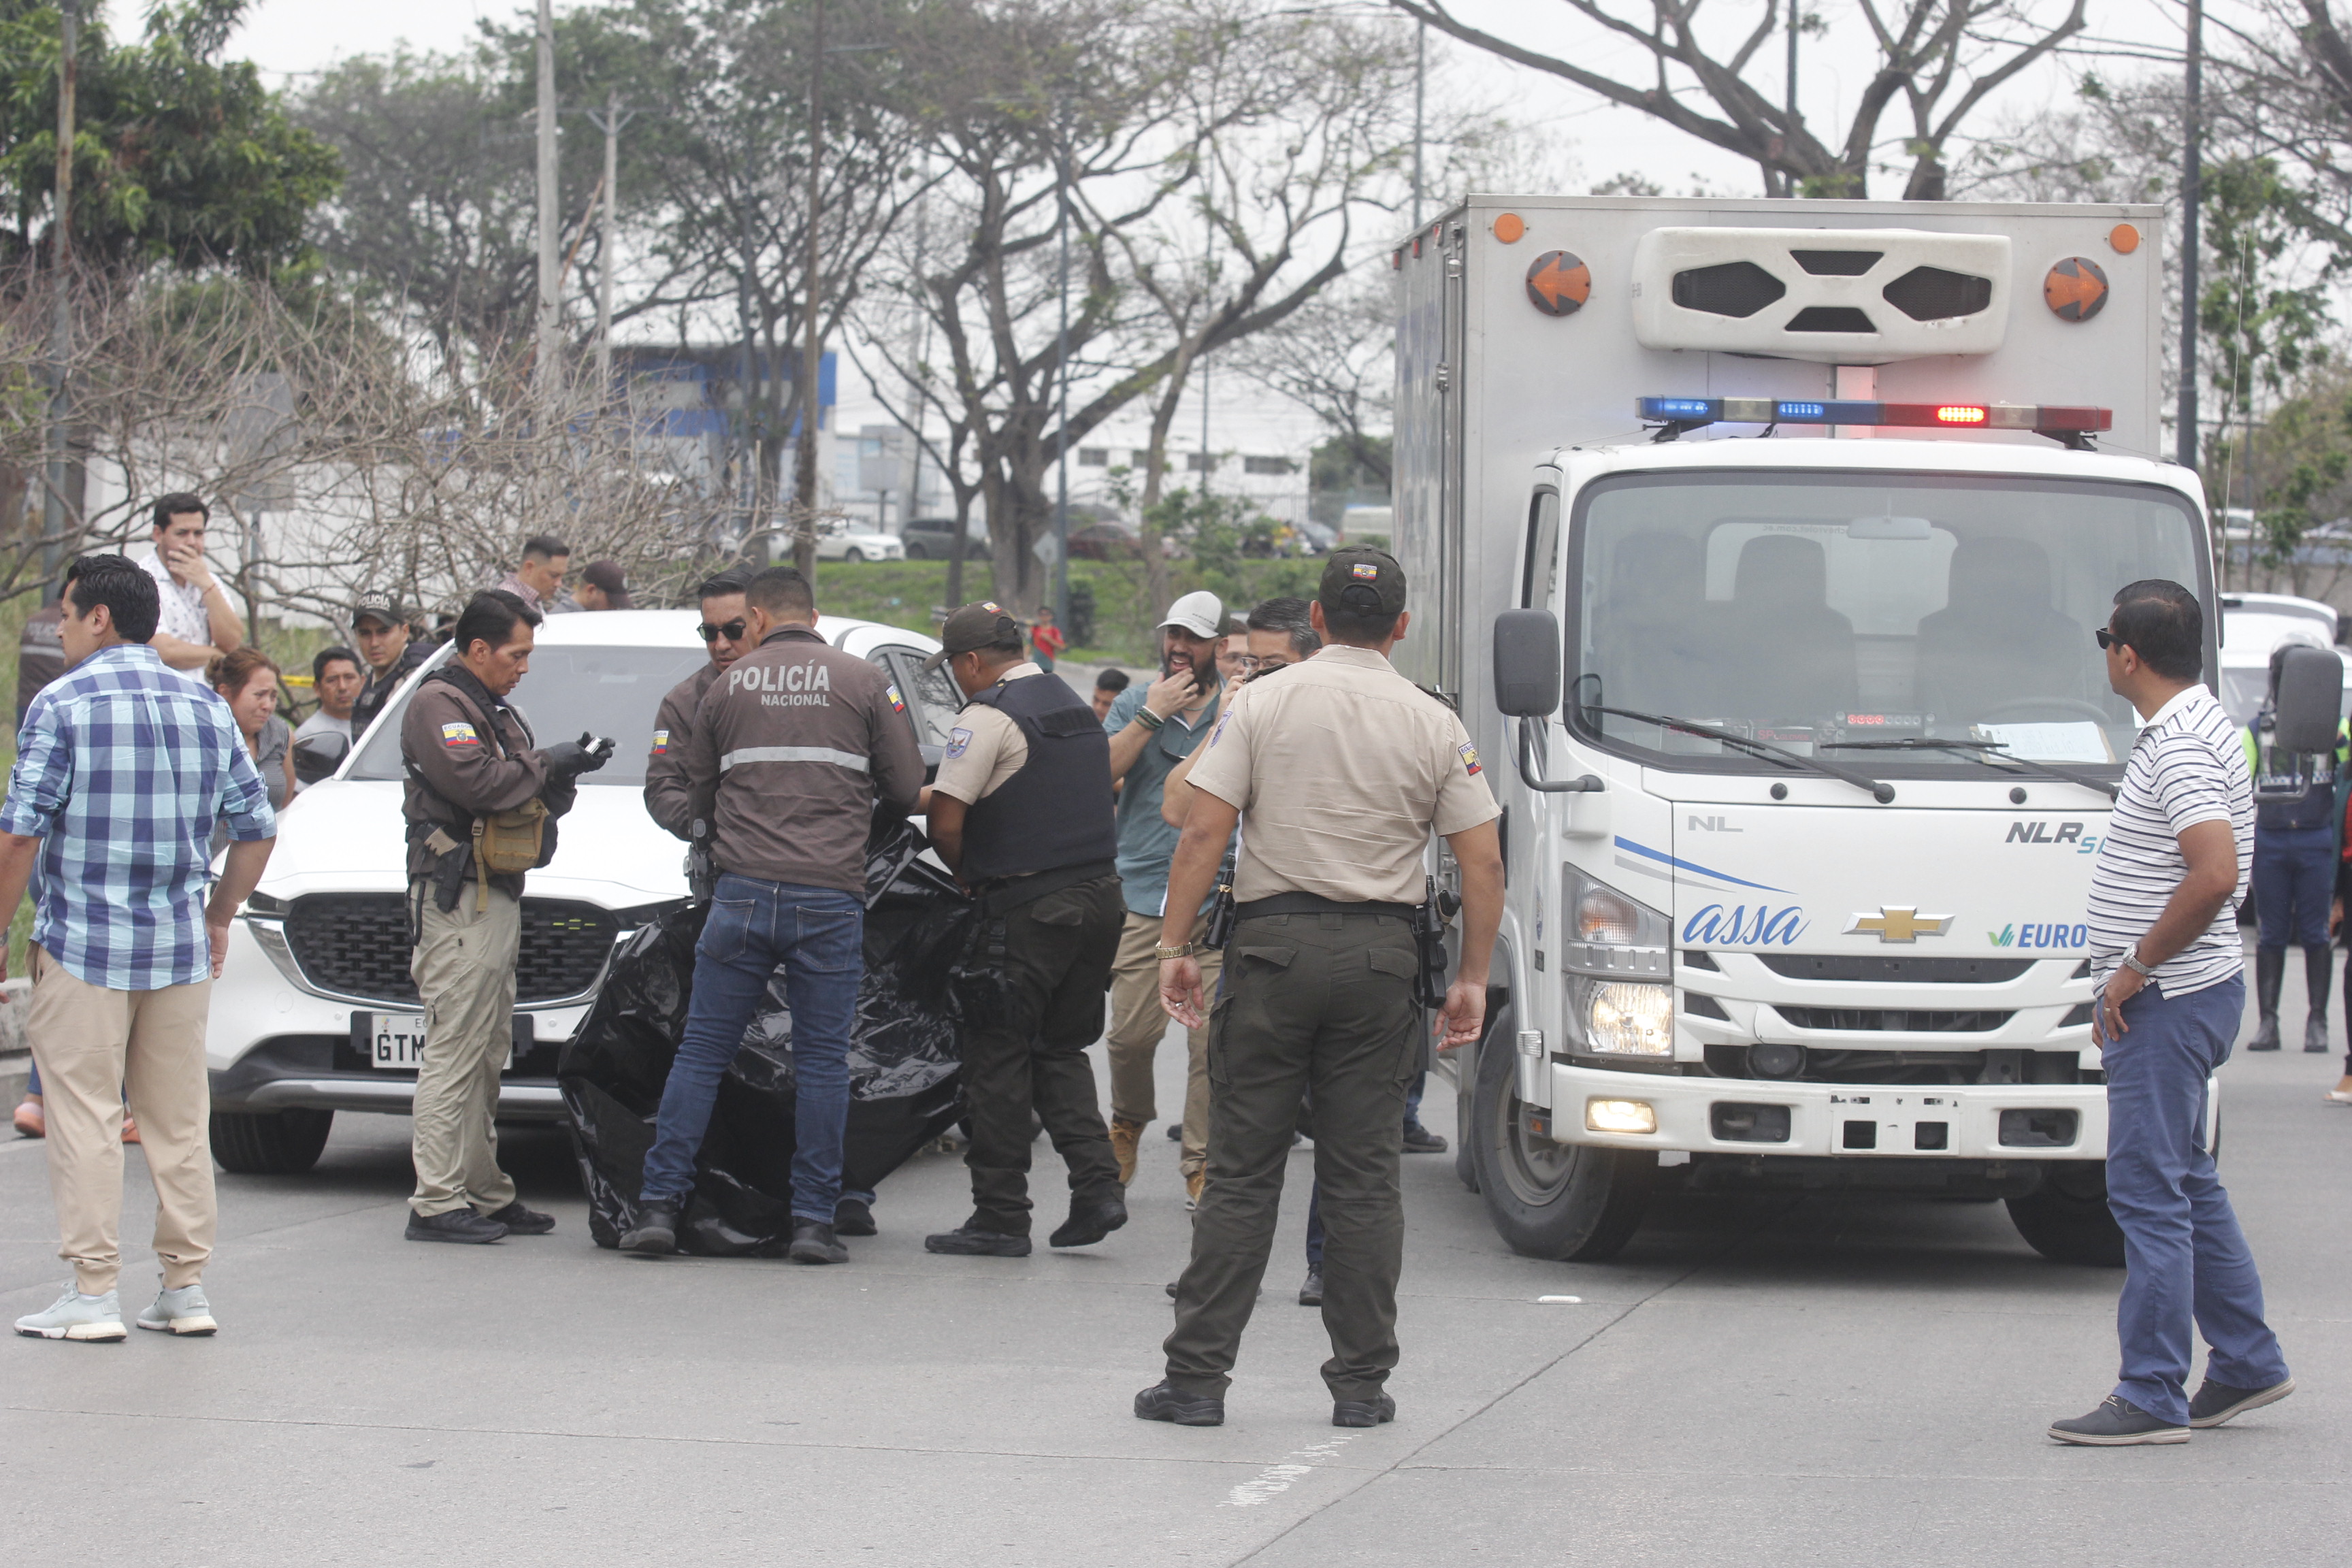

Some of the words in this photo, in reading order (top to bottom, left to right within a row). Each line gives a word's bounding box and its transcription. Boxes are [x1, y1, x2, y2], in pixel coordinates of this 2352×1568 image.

[729, 659, 830, 696] POLICÍA
[761, 693, 830, 707] NACIONAL
[1688, 815, 1744, 832] NL
[2005, 821, 2085, 844] NLR
[1682, 904, 1812, 946] assa
[2017, 924, 2087, 948] EURO
